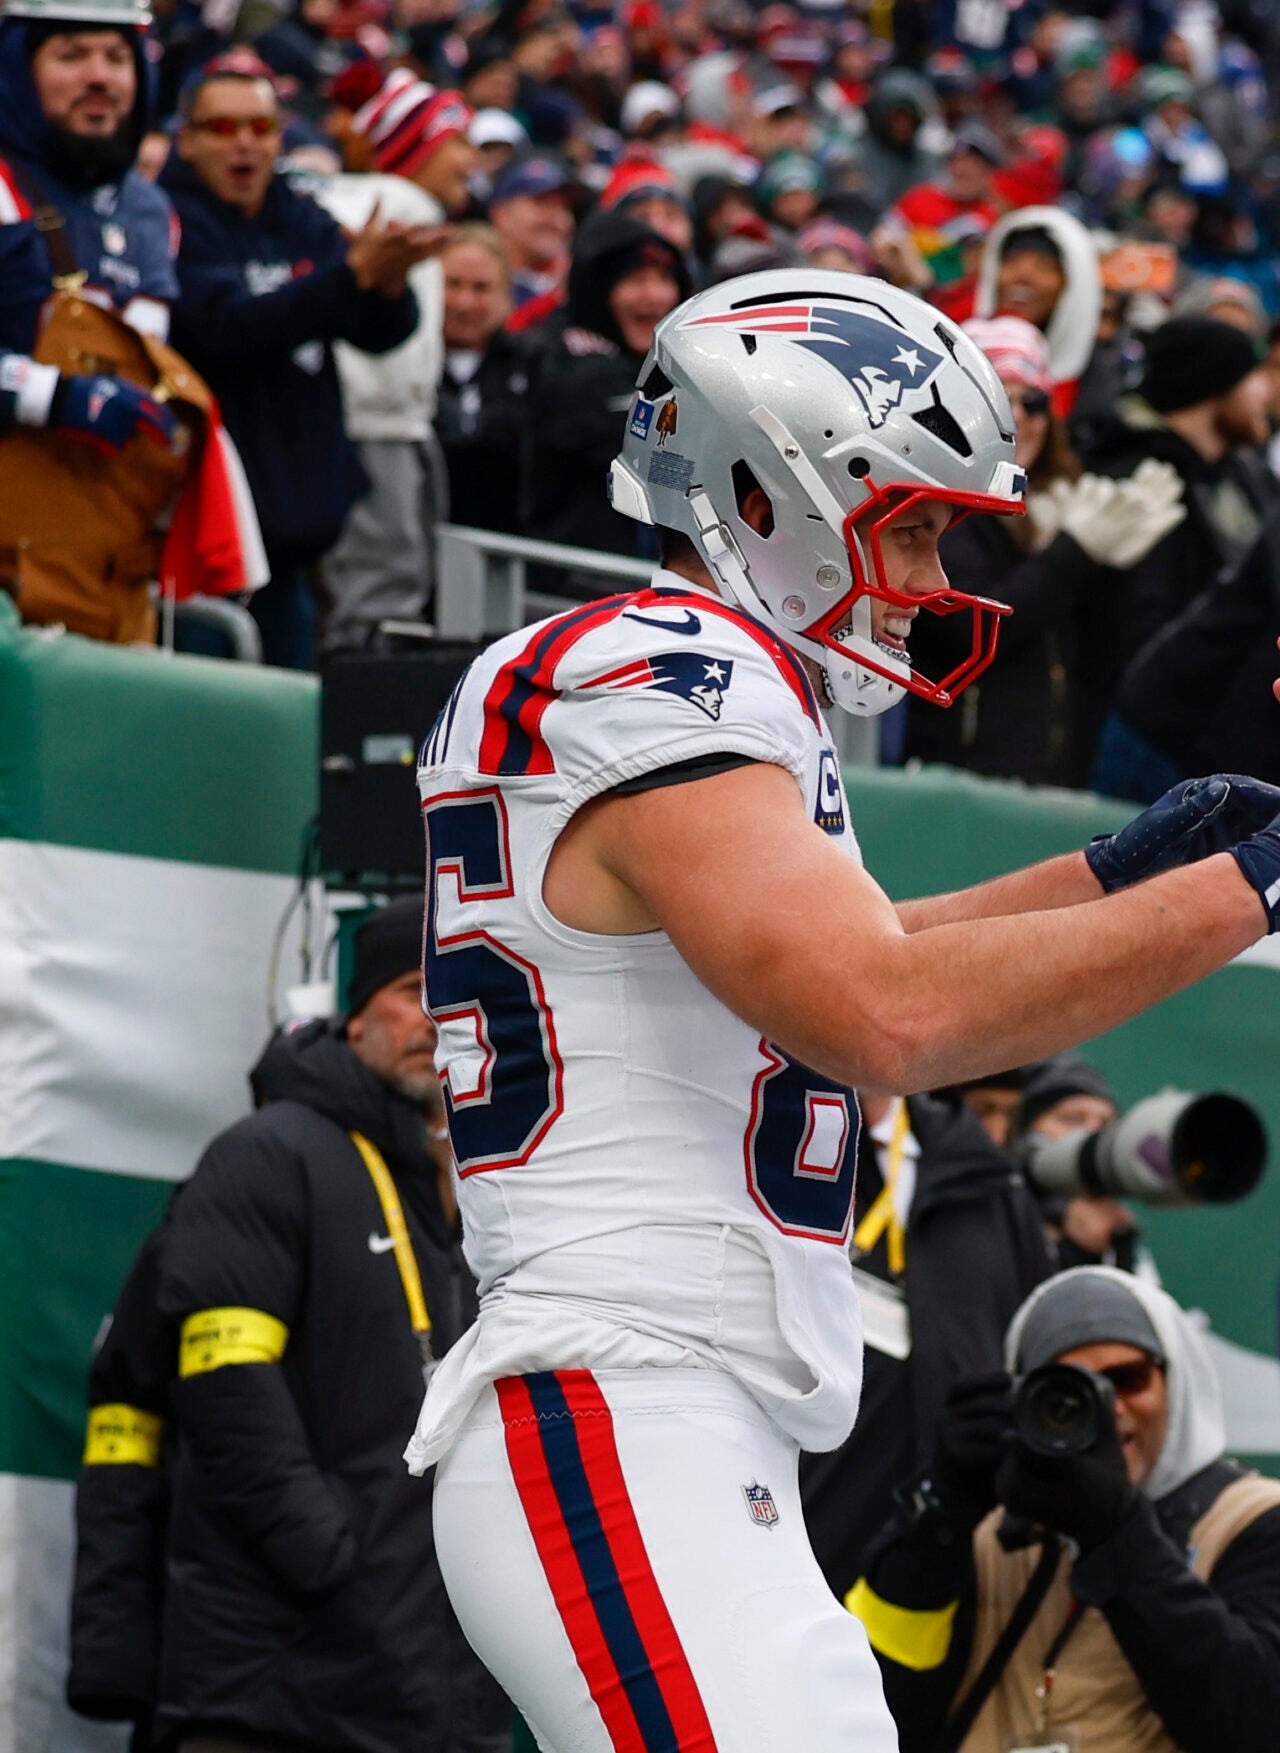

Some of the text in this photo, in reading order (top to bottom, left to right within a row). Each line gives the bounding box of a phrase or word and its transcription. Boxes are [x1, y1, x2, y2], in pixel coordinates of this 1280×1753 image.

[820, 756, 841, 813] C
[420, 784, 564, 1180] 5
[752, 1501, 776, 1520] NFL
